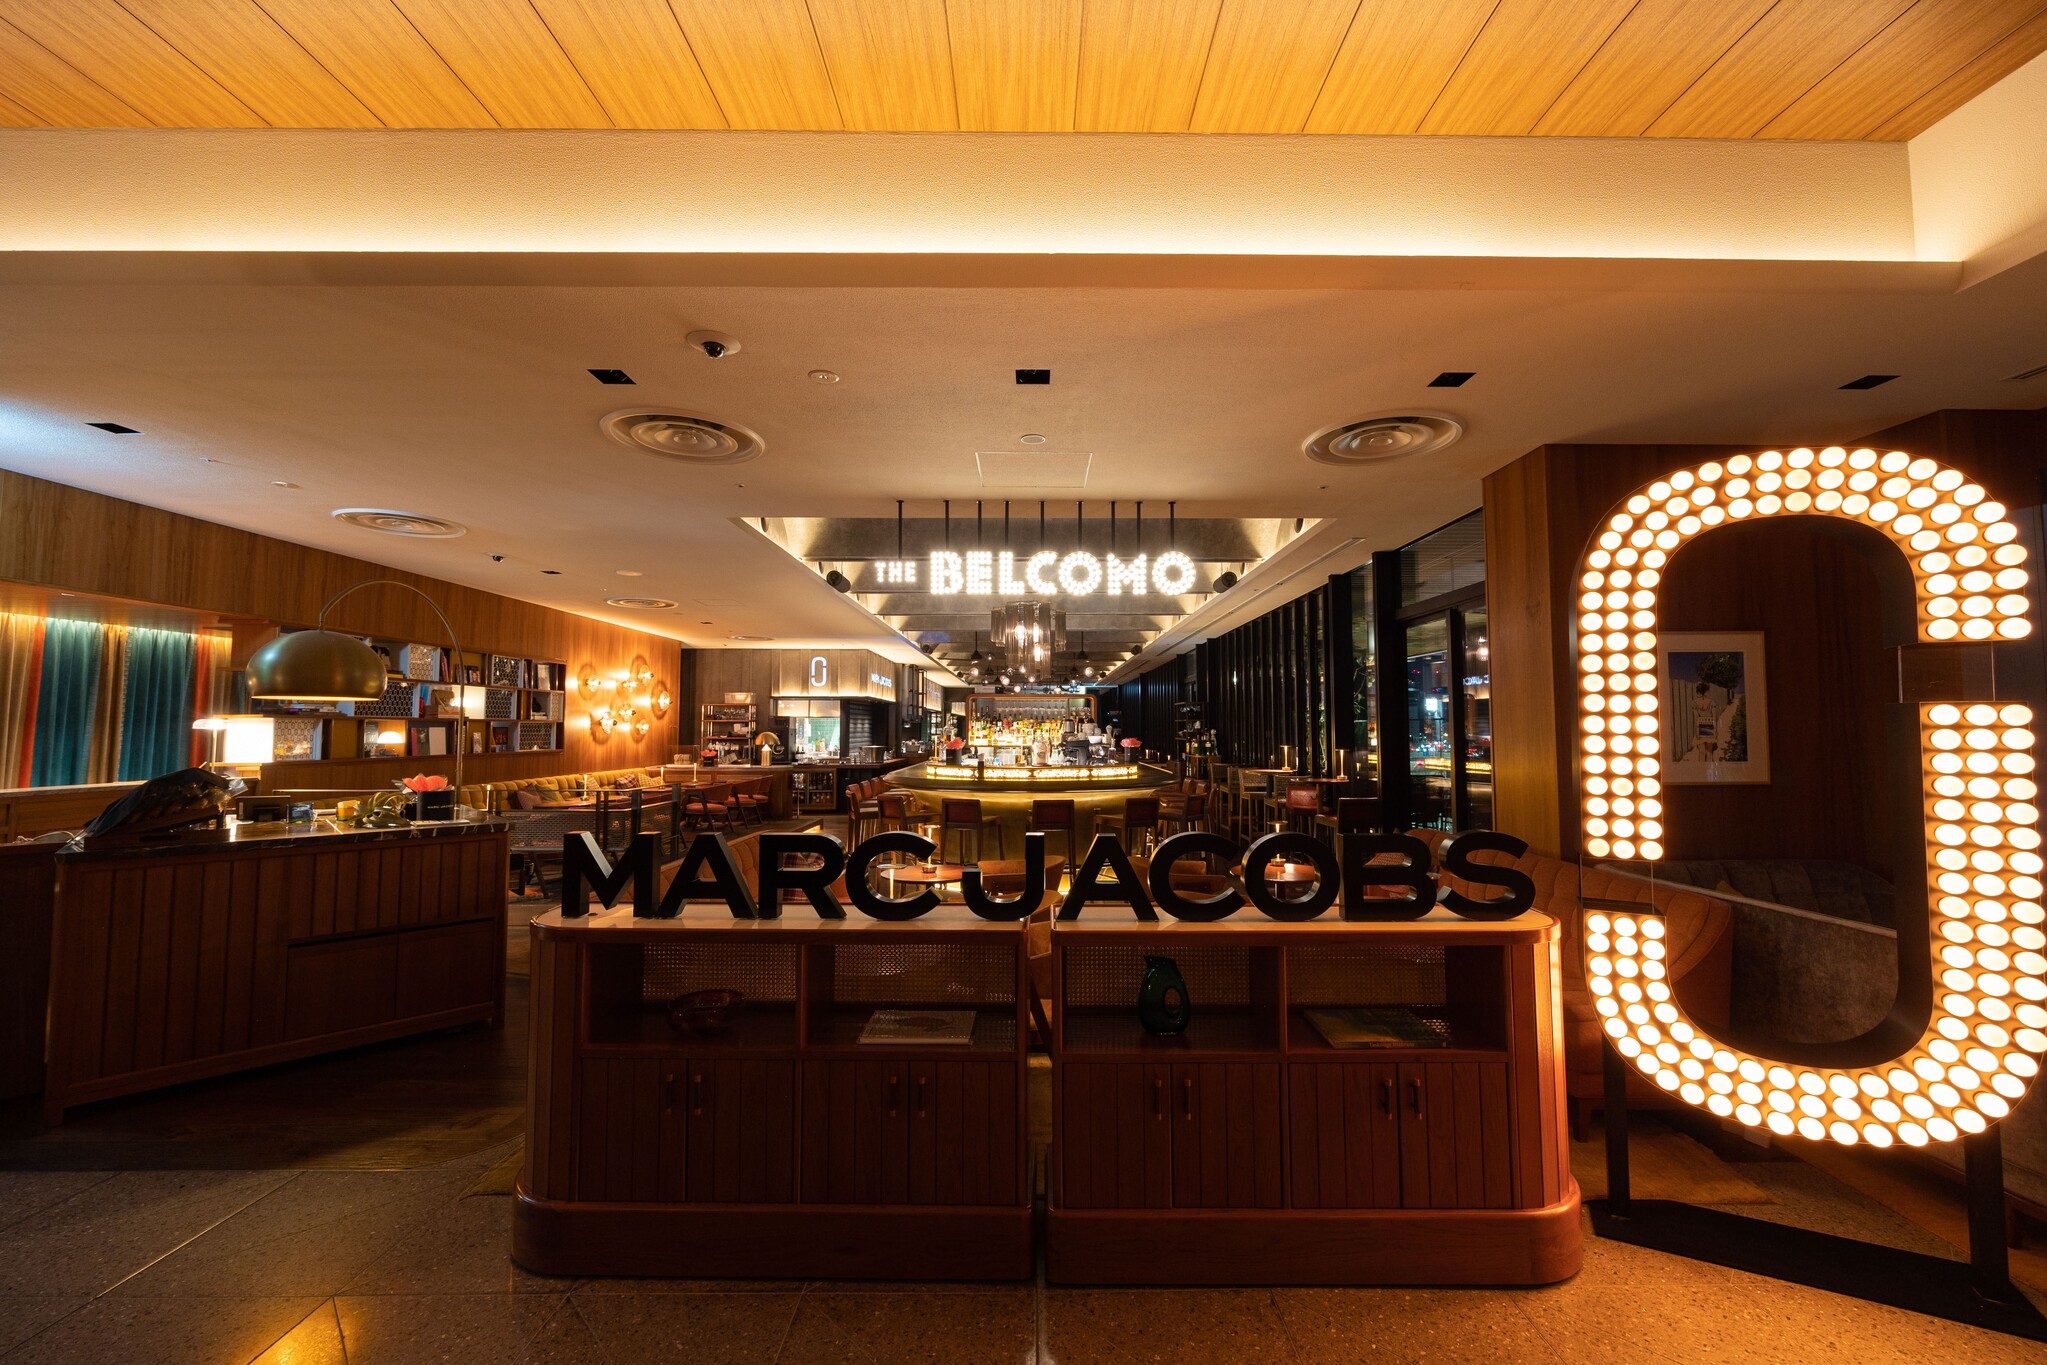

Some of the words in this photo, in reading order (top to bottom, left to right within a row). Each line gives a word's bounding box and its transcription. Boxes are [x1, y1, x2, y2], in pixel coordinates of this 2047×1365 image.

[874, 560, 917, 583] THE
[929, 550, 1196, 596] BELCOMO
[561, 831, 943, 921] MARC
[962, 831, 1535, 922] JACOBS
